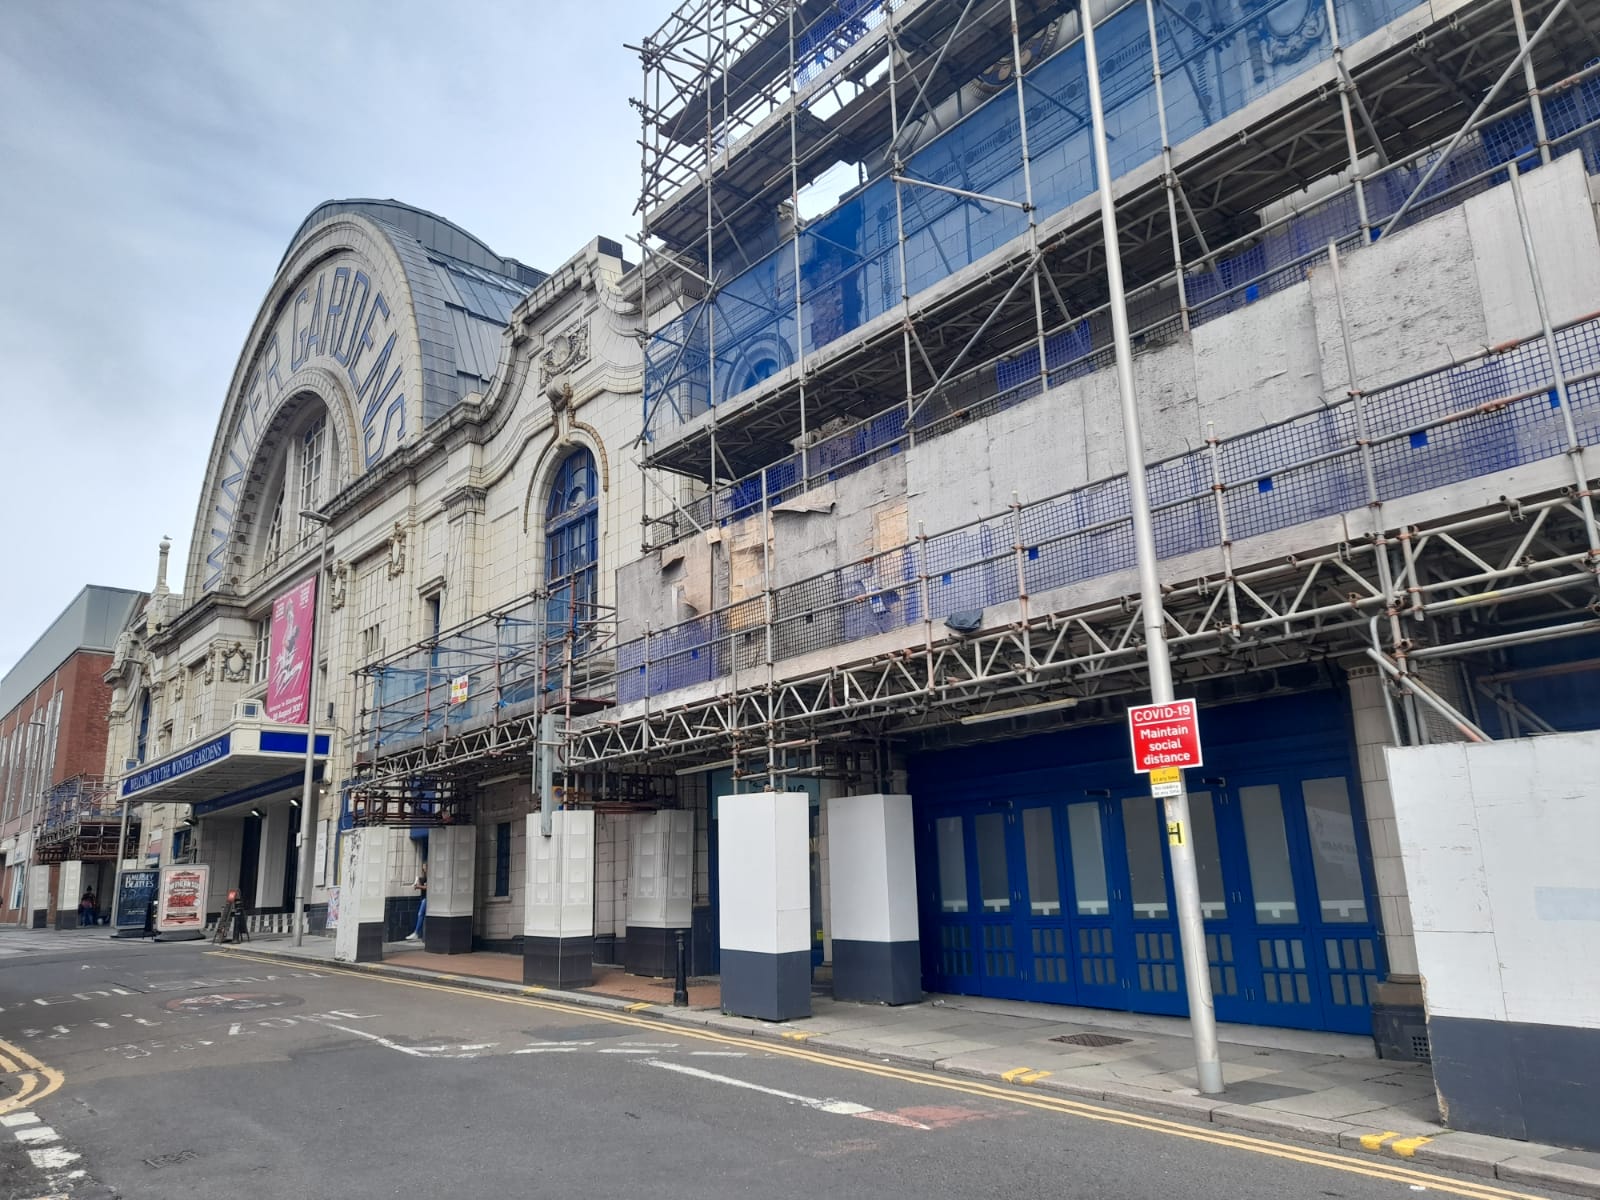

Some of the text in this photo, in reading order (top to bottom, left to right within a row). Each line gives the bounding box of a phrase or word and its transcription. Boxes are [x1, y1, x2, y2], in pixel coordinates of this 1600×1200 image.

[203, 267, 406, 591] WINTER GARDENS
[1134, 704, 1191, 722] COVID-19
[1140, 725, 1189, 740] Maintain
[1149, 737, 1182, 752] social
[130, 741, 223, 791] WELCOME TO THE WINTER GARDENS
[1143, 752, 1191, 766] distance
[1167, 822, 1182, 844] H
